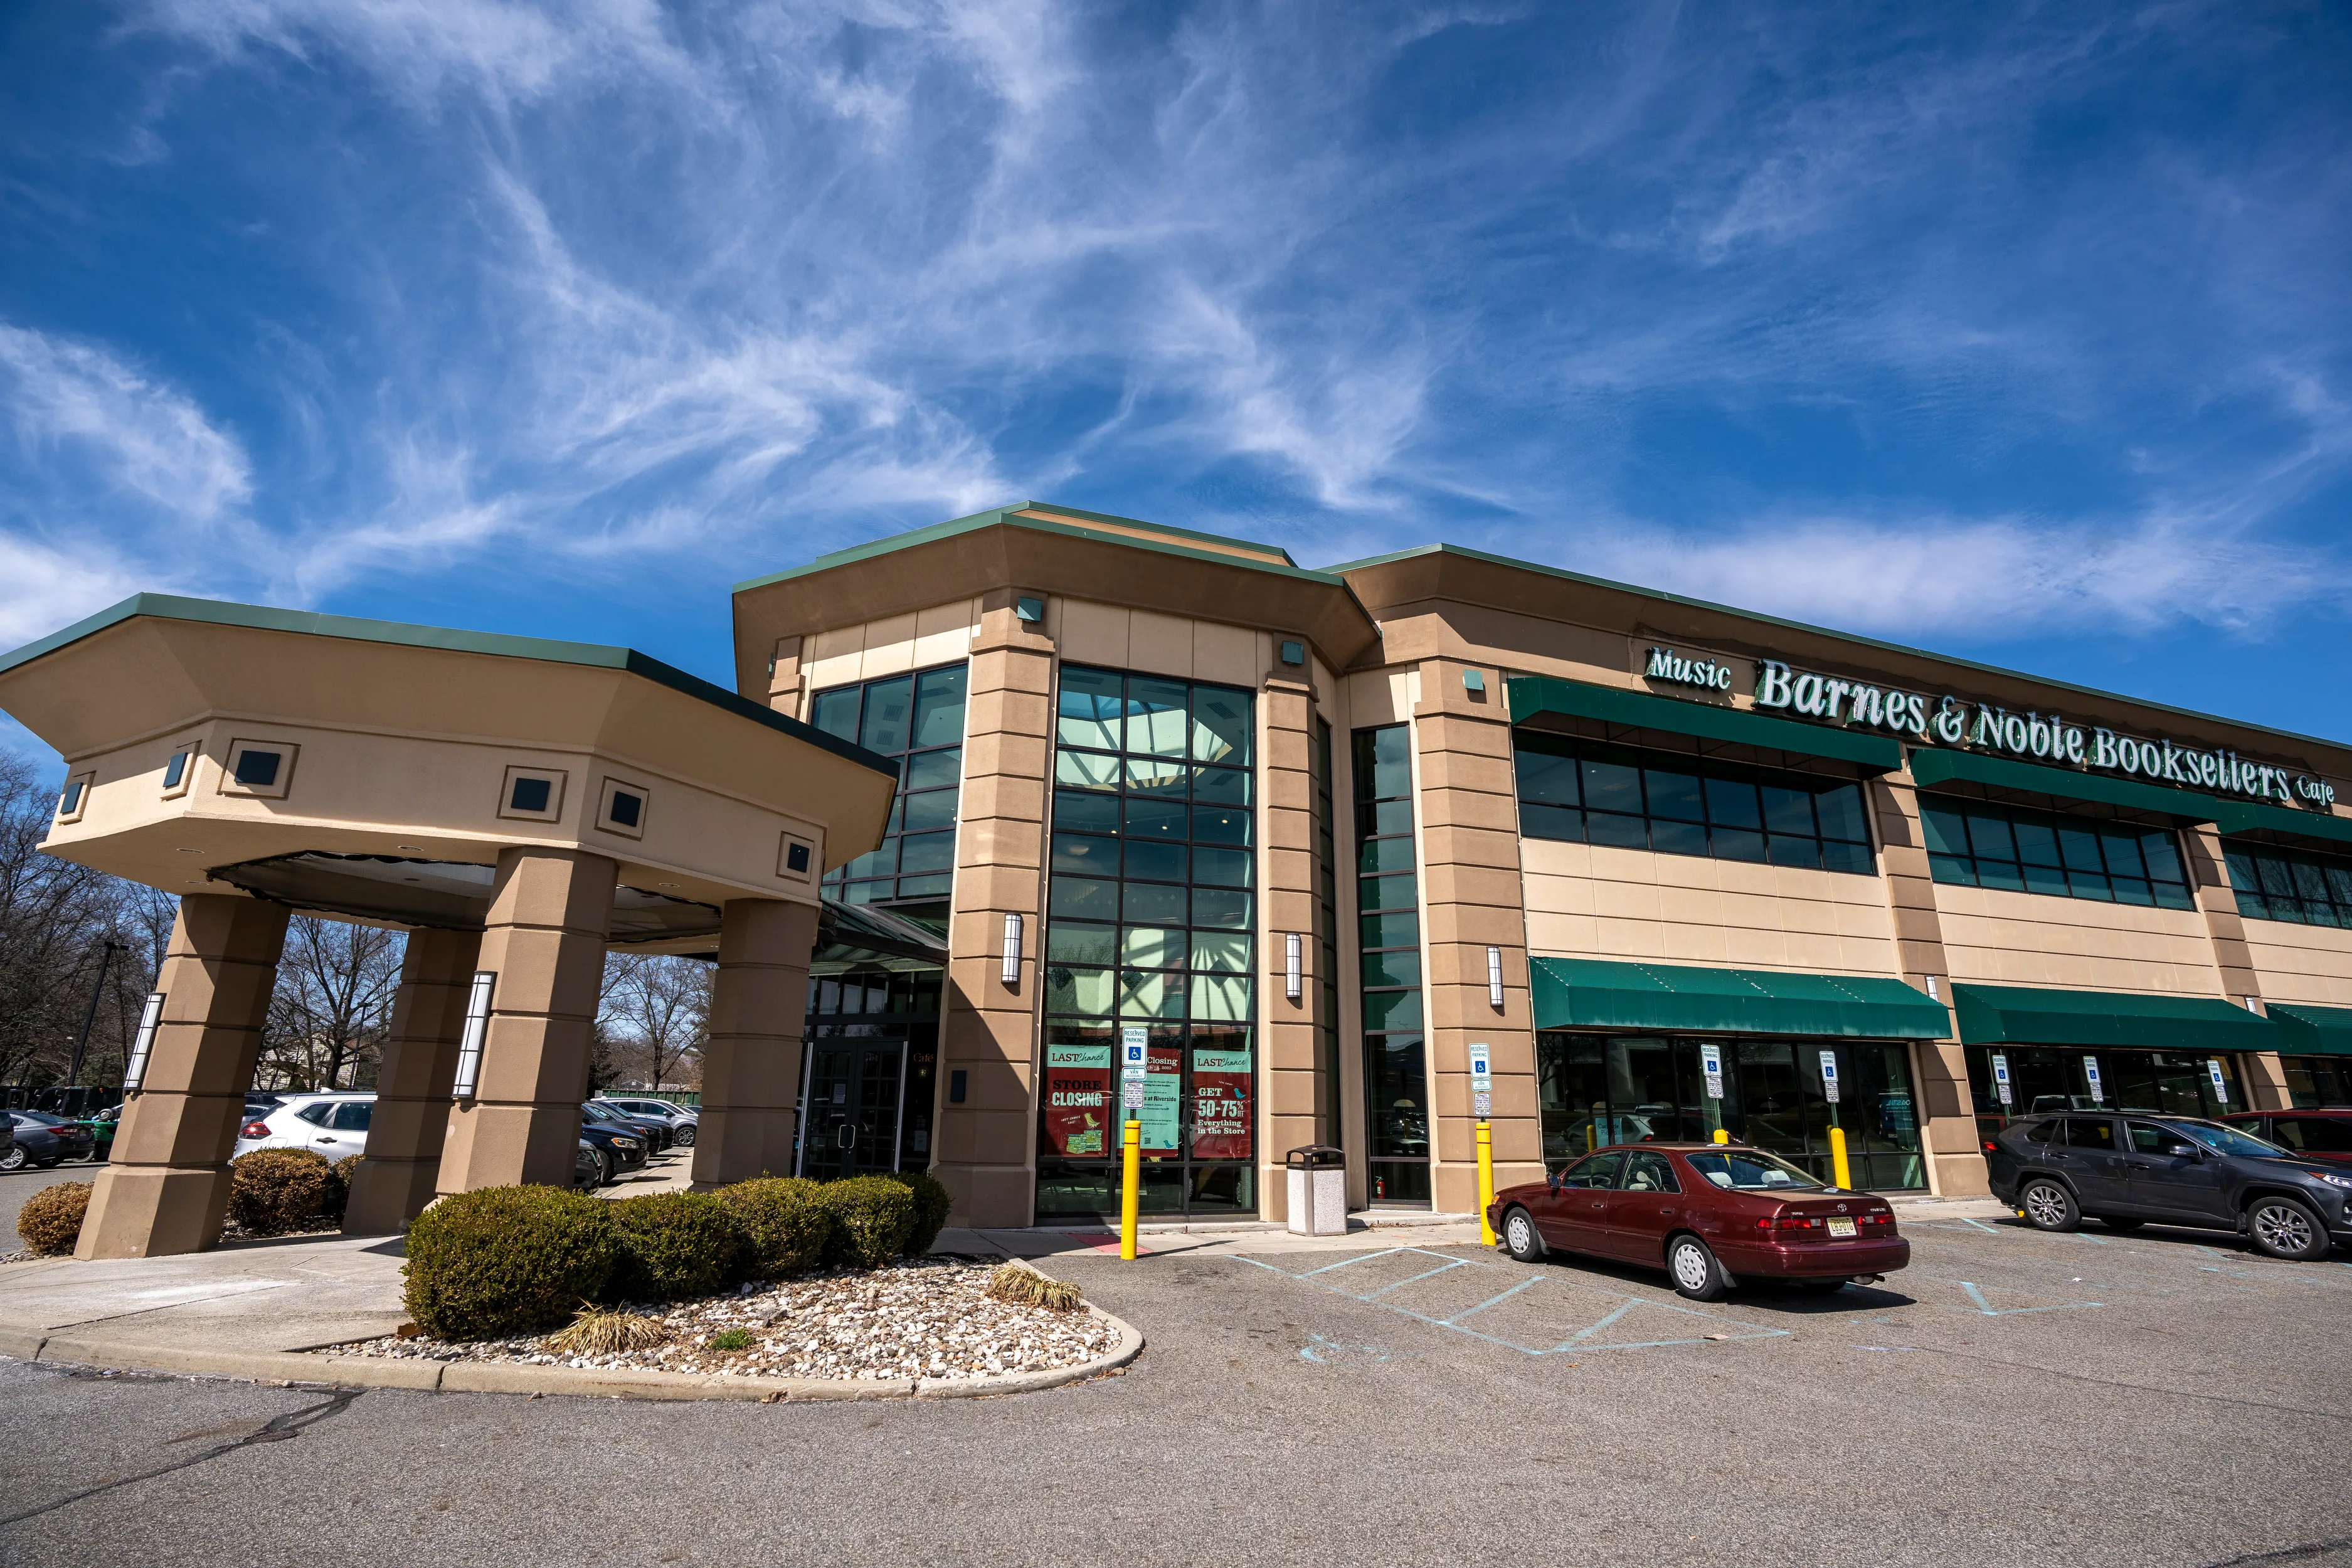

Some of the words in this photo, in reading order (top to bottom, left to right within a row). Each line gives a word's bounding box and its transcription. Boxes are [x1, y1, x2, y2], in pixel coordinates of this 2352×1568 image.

[1649, 646, 1731, 690] Music
[1758, 659, 1927, 734] Barnes
[1934, 694, 1965, 743] &
[1976, 702, 2084, 764] Noble
[2092, 726, 2291, 802] Booksellers
[913, 1052, 934, 1062] Café
[1052, 1053, 1079, 1062] LAST
[1076, 1052, 1104, 1062] Chance
[1147, 1057, 1178, 1066] Closing
[1197, 1058, 1222, 1066] LAST
[1220, 1057, 1246, 1067] Chance
[1053, 1080, 1101, 1090] STORE
[1199, 1088, 1222, 1096] GET
[1052, 1092, 1102, 1106] CLOSING
